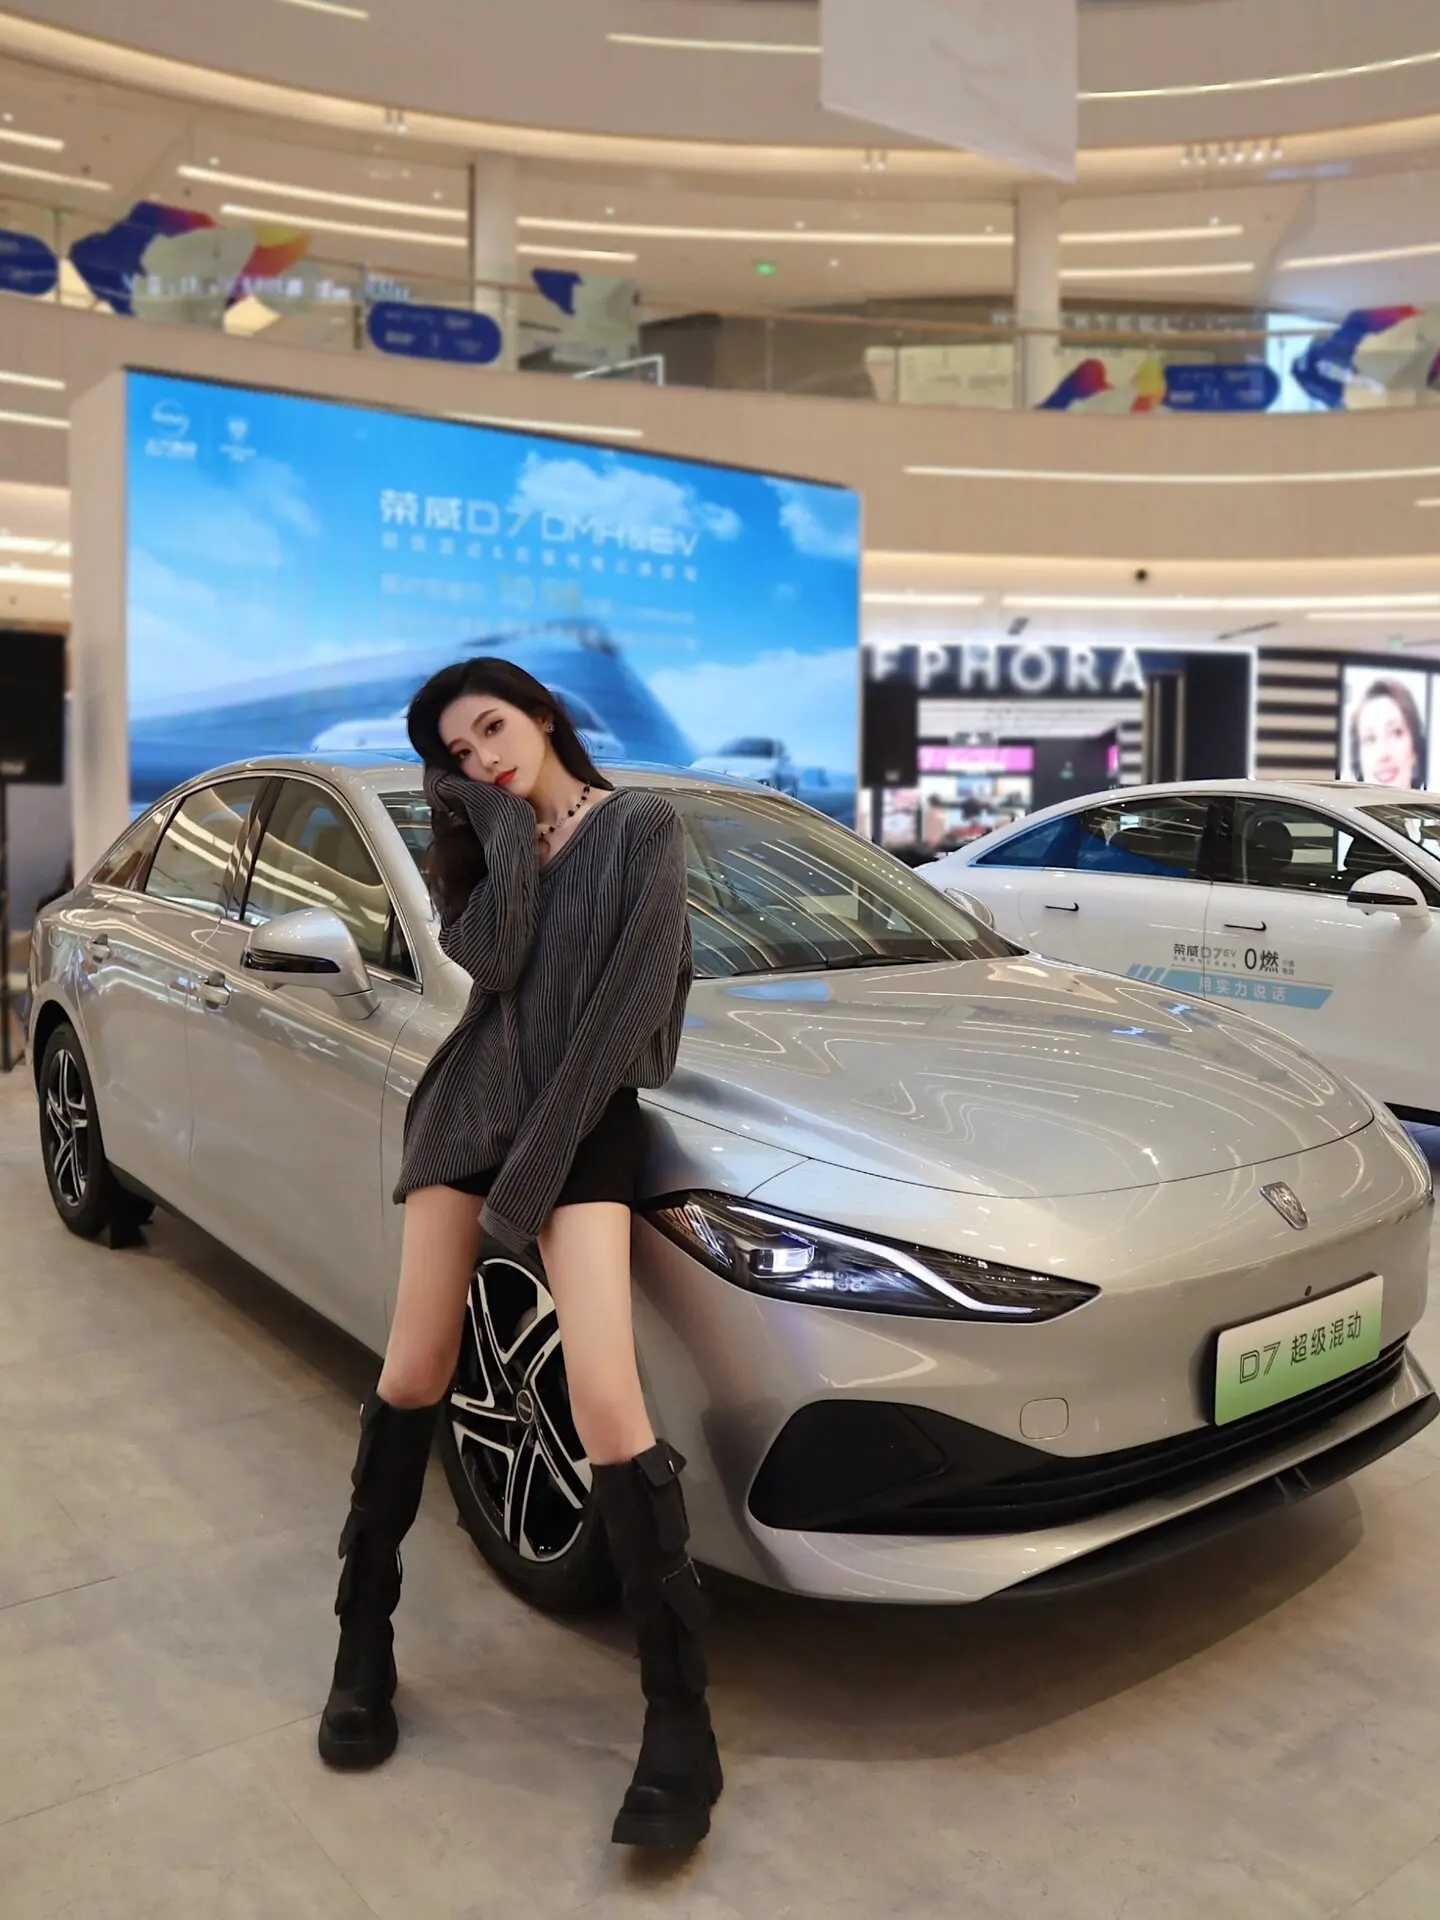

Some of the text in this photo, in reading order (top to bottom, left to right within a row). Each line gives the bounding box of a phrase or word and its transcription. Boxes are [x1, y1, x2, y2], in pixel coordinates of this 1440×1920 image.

[1200, 976, 1287, 1001] 用实力说话
[1239, 1310, 1363, 1384] D7 超级混动
